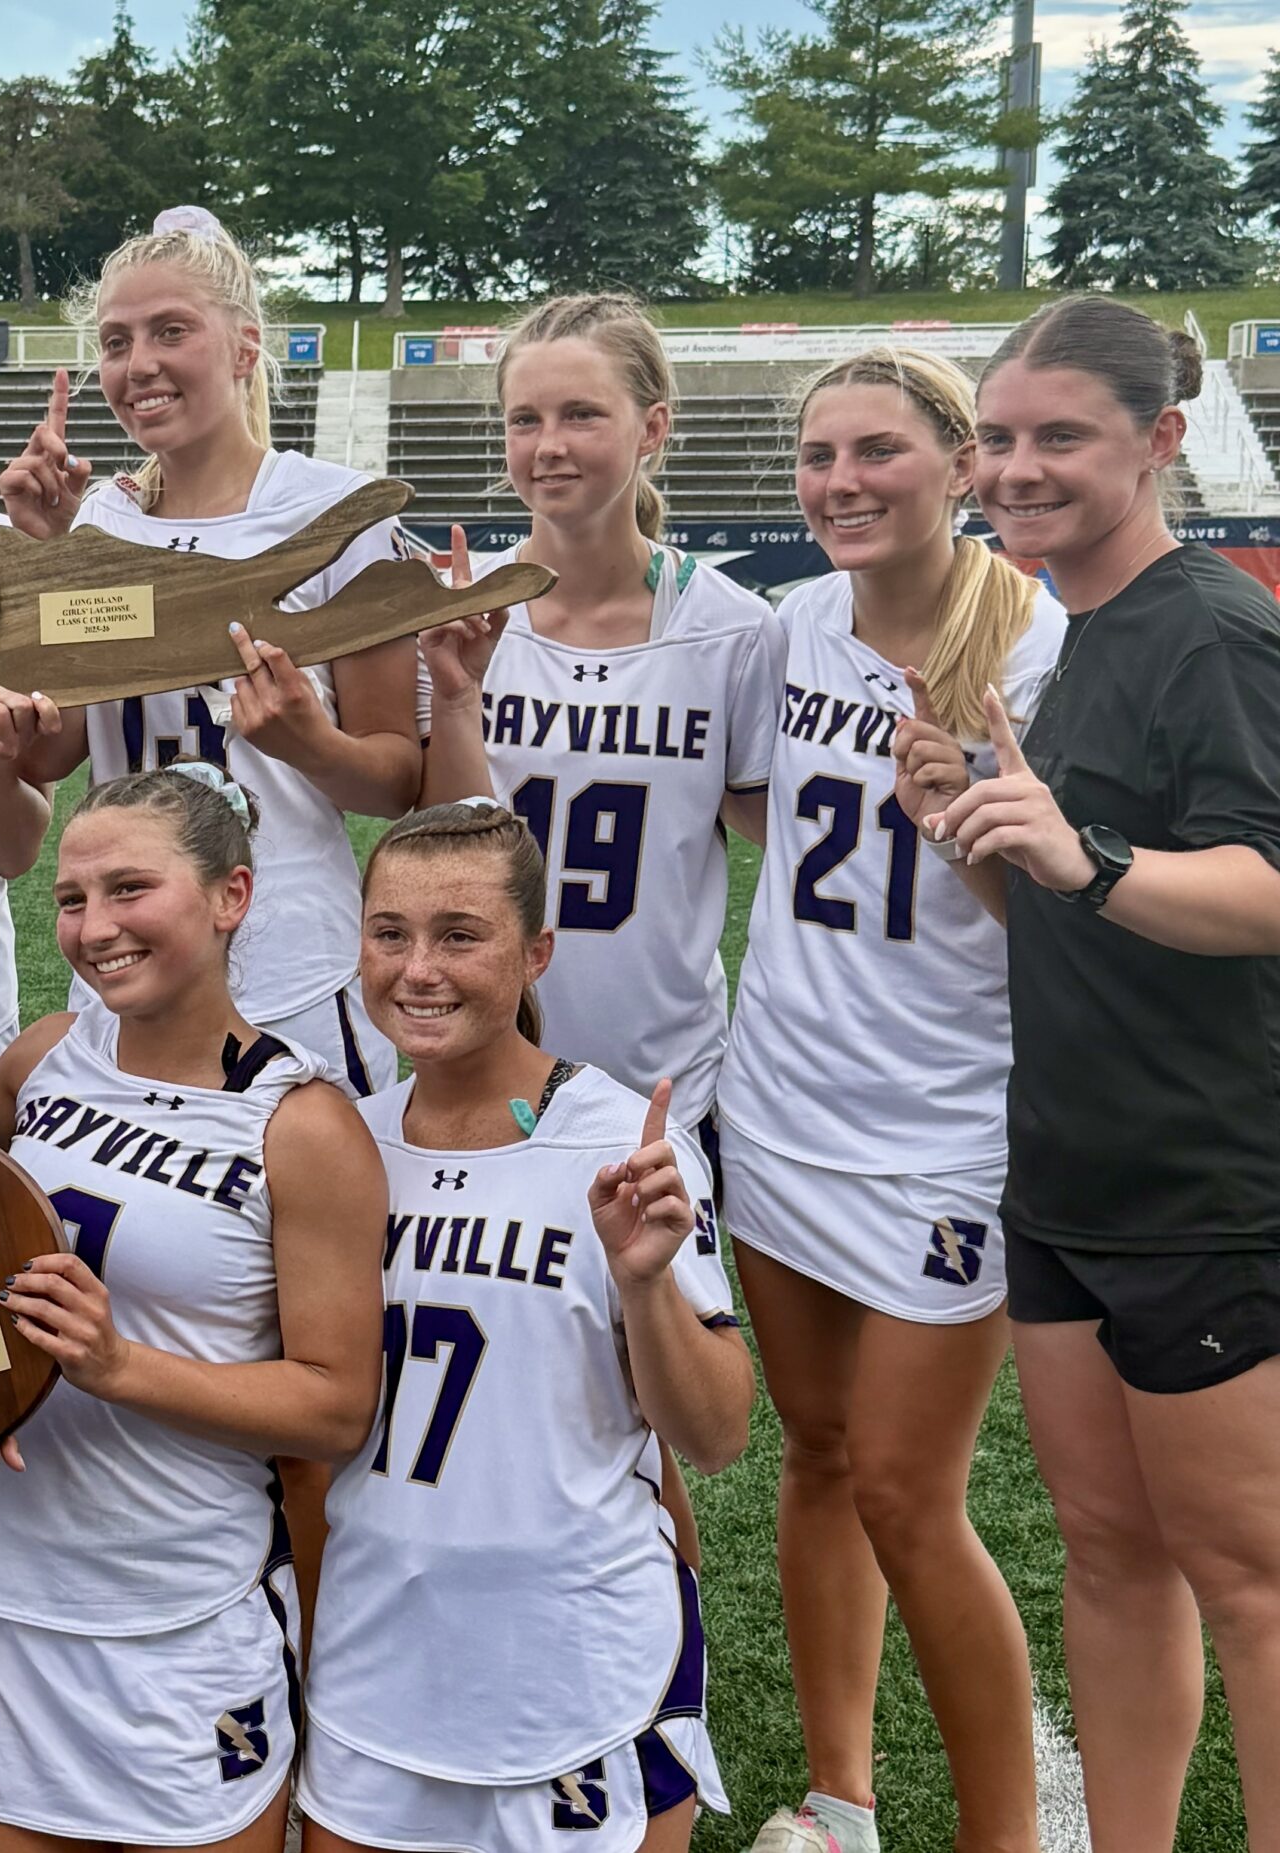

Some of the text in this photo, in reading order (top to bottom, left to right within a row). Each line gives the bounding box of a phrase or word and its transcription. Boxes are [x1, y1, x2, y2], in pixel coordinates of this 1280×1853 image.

[749, 531, 799, 544] STONY
[70, 596, 123, 607] LONG ISLAND
[90, 604, 130, 615] LACROSSE
[56, 613, 138, 626] CLASS C CHAMPIONS
[793, 770, 920, 944] 21
[17, 1096, 264, 1213] SAYVILLE
